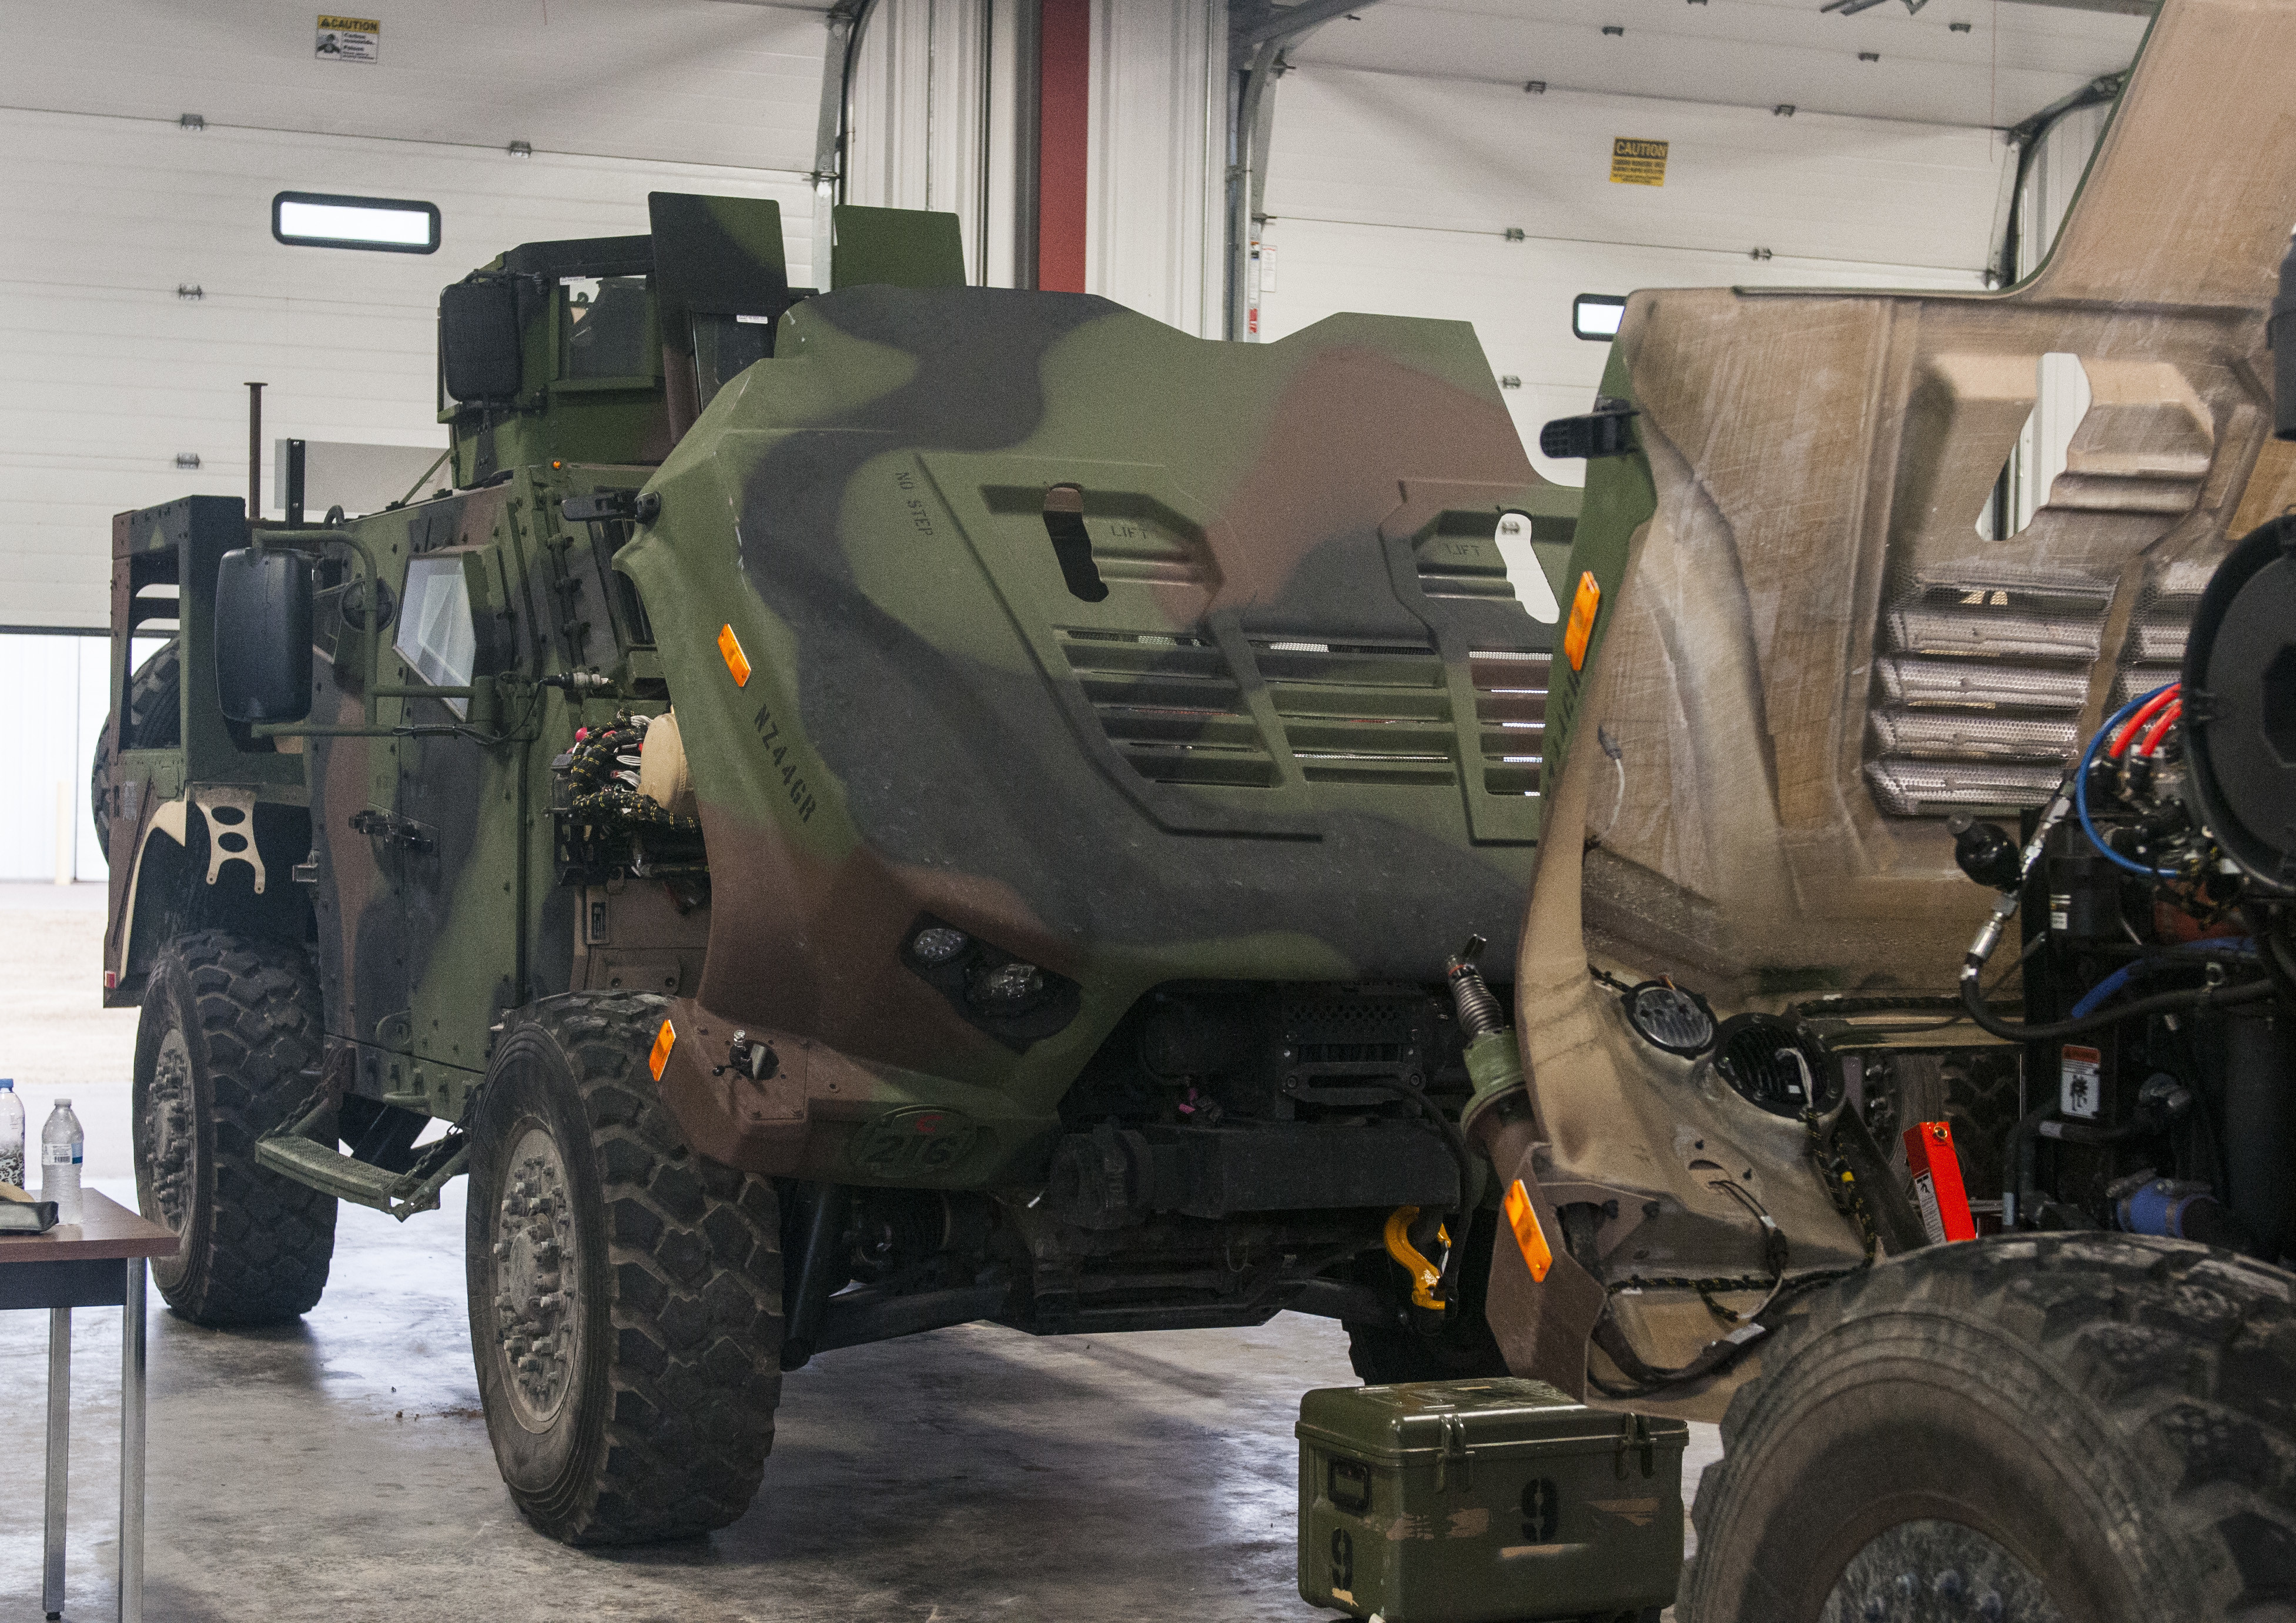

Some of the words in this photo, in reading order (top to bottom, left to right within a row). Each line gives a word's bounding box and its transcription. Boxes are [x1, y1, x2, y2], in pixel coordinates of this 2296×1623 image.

[331, 18, 377, 31] CAUTION
[1616, 141, 1666, 158] CAUTION
[895, 472, 914, 490] NO
[907, 500, 933, 536] STEP
[1110, 526, 1147, 540] LIFT
[1444, 544, 1481, 556] LIFT
[1521, 1477, 1559, 1542] 9
[1331, 1528, 1353, 1591] 9
